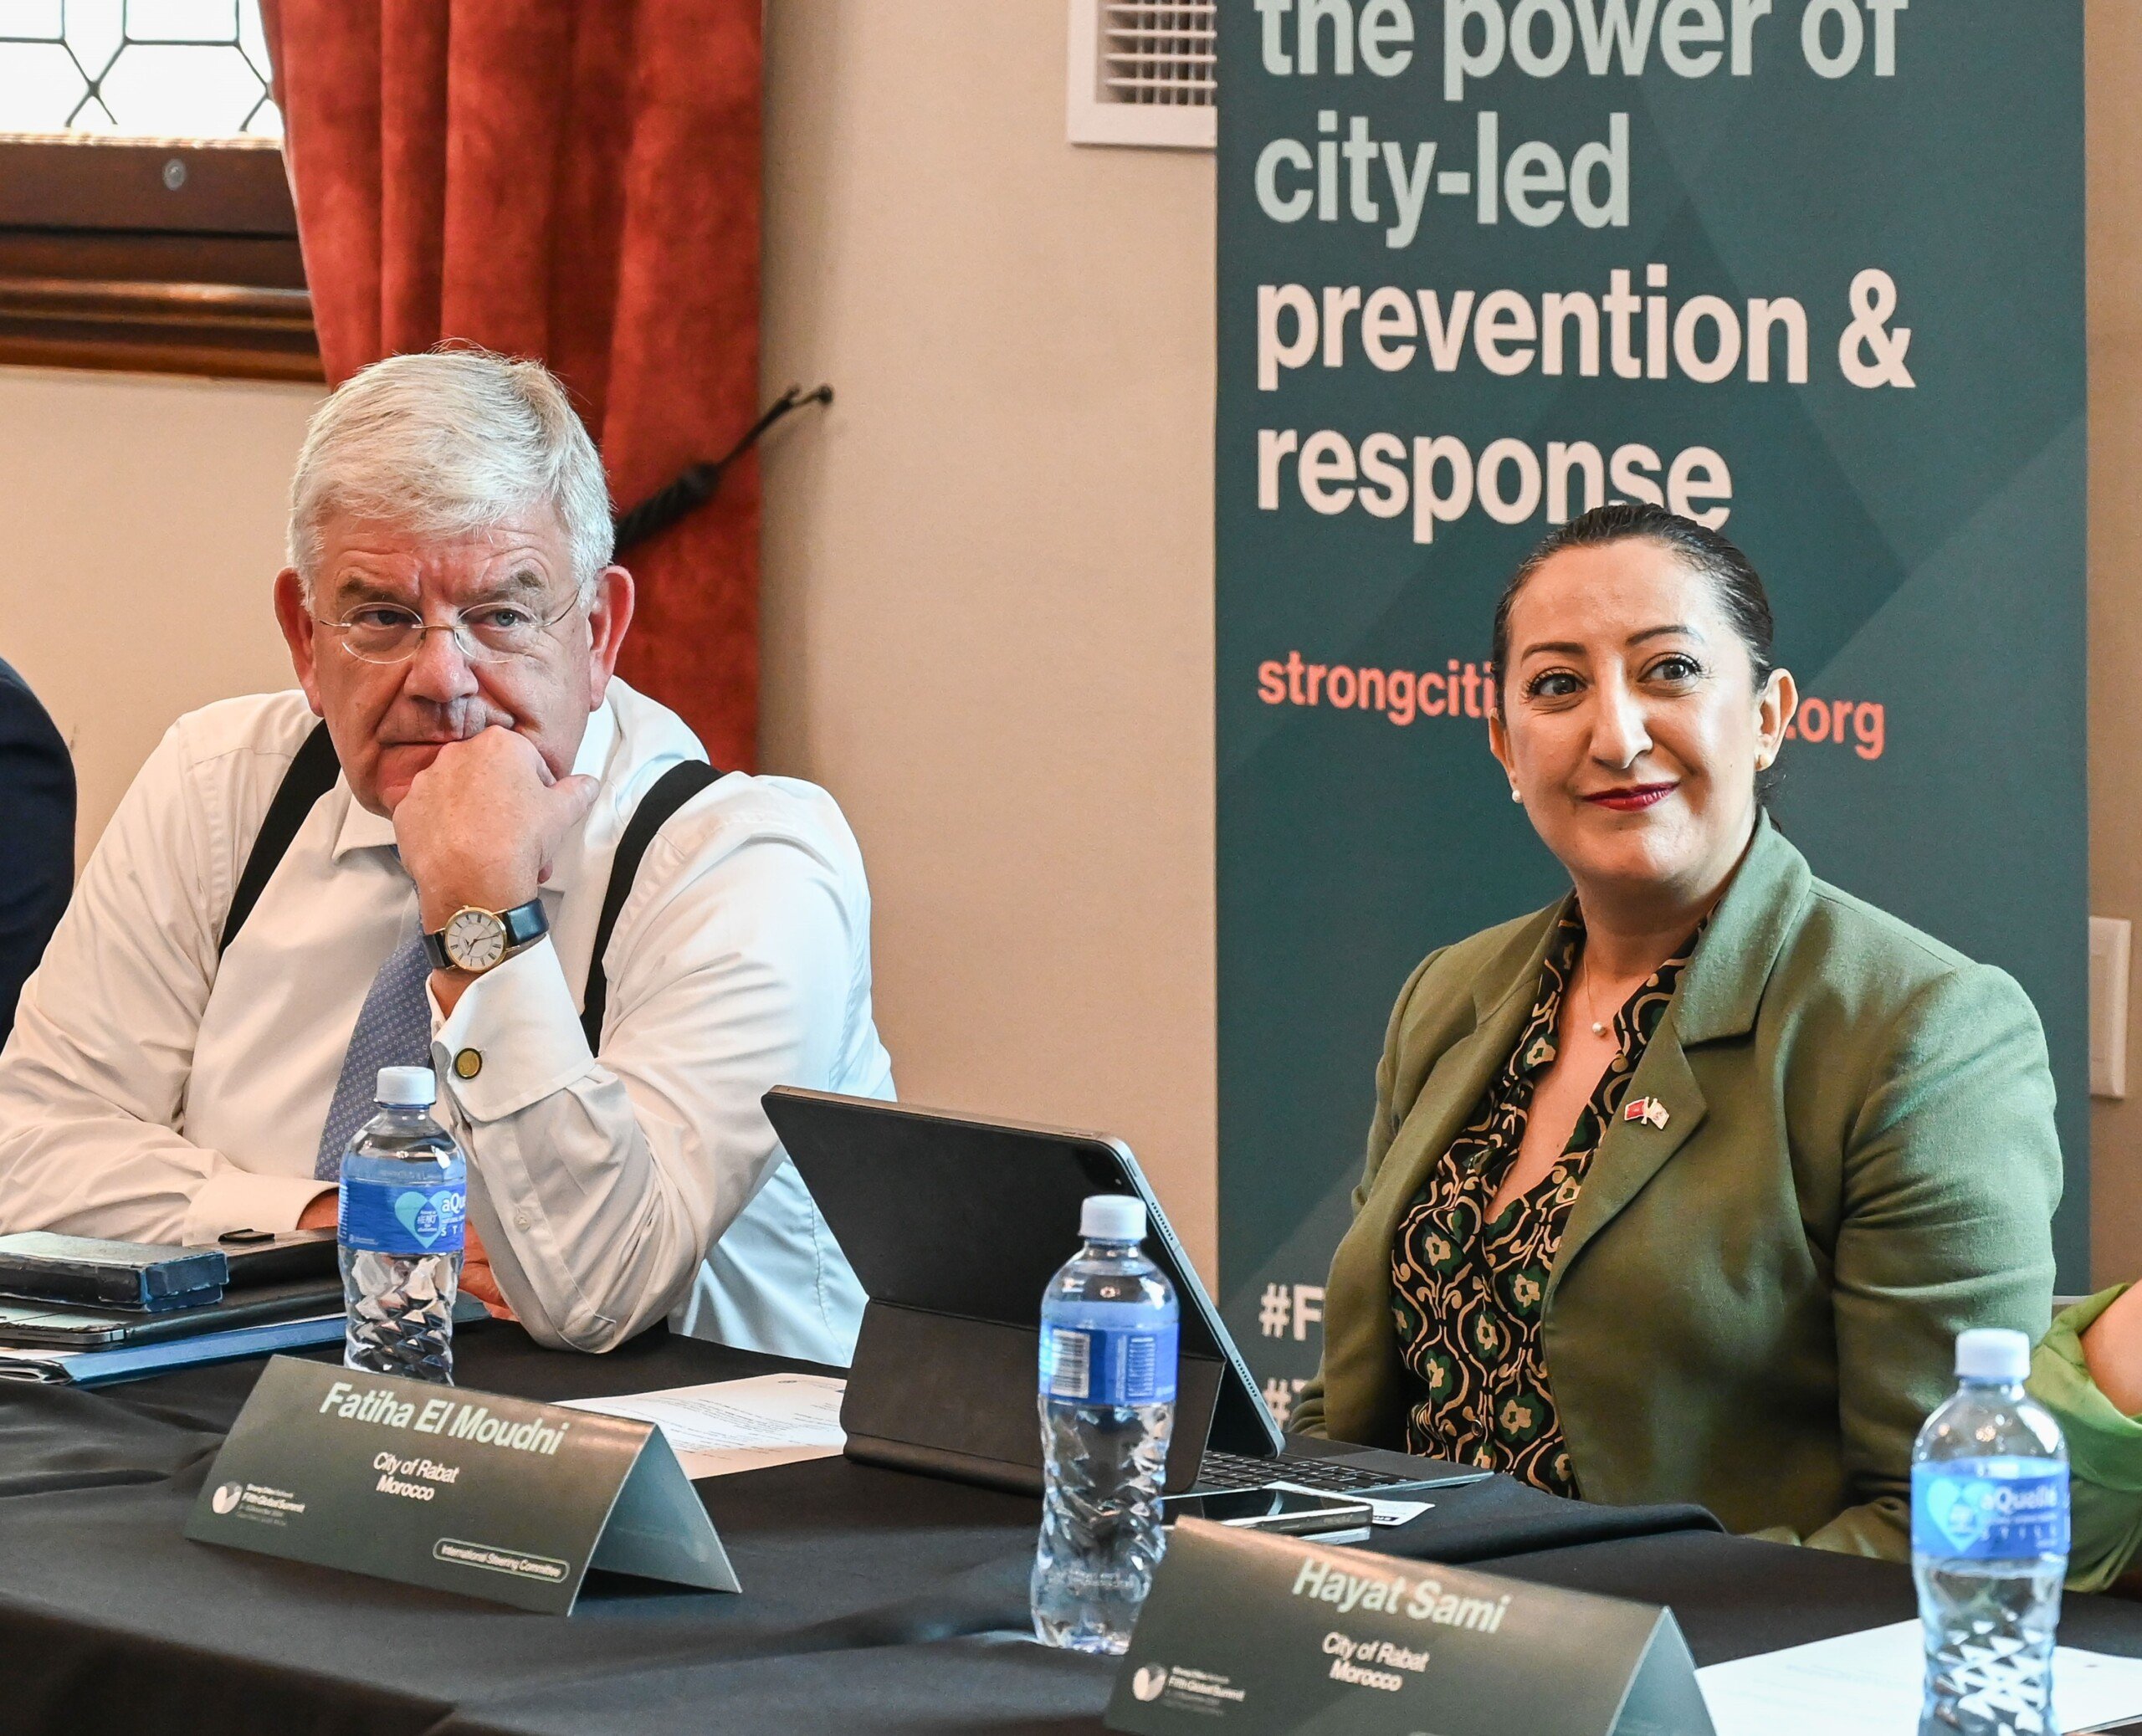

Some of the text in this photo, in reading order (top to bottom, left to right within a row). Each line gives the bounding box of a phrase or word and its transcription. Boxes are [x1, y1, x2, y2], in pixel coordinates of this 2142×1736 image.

[1253, 0, 1909, 101] the power of
[1254, 110, 1629, 249] city-led
[1257, 264, 1917, 392] prevention &
[1257, 428, 1733, 545] response
[1258, 650, 1496, 726] strongciti
[320, 1380, 416, 1428] Fatiha
[414, 1398, 456, 1435] El
[447, 1404, 570, 1456] Moudni
[373, 1452, 460, 1483] City of Rabat
[376, 1474, 435, 1501] Morocco
[1291, 1556, 1513, 1634] Hayat Sami
[1322, 1631, 1431, 1672] City of Rabat
[1329, 1658, 1403, 1692] Morocco
